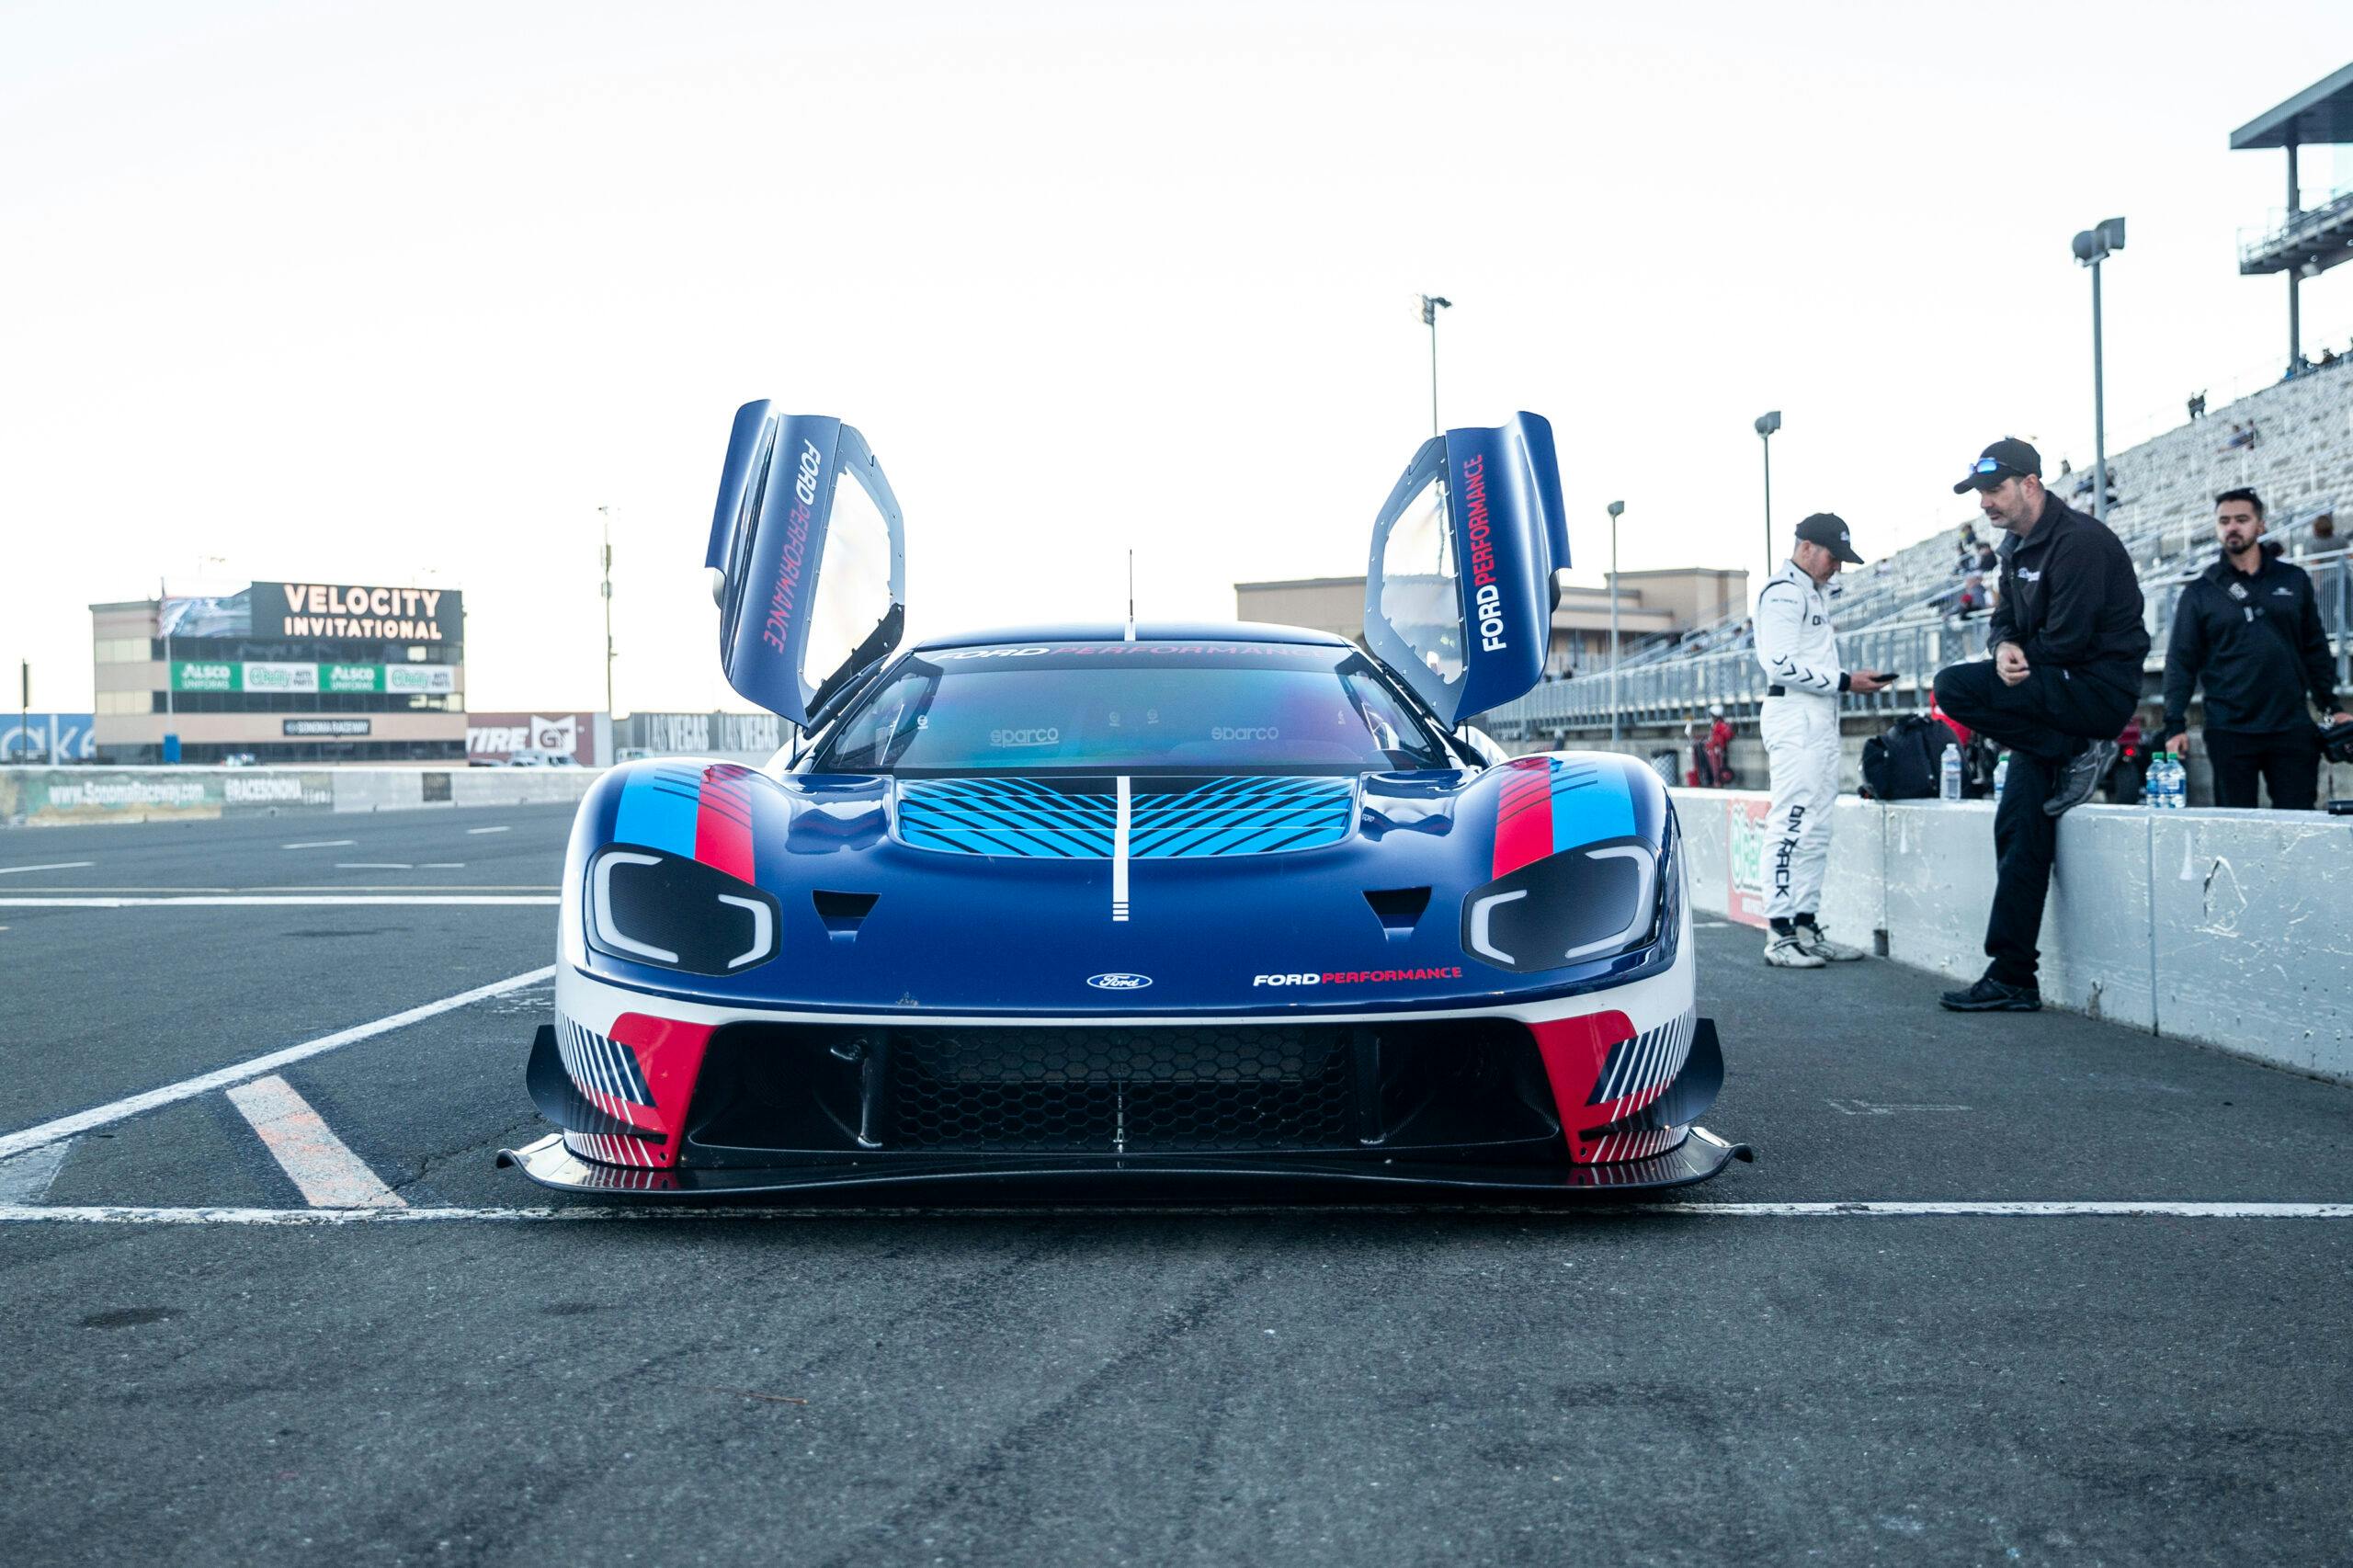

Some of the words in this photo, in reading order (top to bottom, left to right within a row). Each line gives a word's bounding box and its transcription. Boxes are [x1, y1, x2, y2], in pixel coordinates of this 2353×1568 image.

[796, 438, 822, 506] FORD
[1463, 454, 1497, 586] PERFORMANCE
[764, 496, 812, 654] PERFORMANCE
[284, 584, 441, 618] VELOCITY
[284, 617, 442, 640] INVITATIONAL
[1476, 585, 1506, 653] FORD
[931, 648, 1050, 662] FORD
[1051, 646, 1325, 657] PERFORMANCE
[990, 727, 1060, 748] sparco
[1253, 973, 1321, 986] FORD
[1322, 967, 1463, 984] PERFORMANCE
